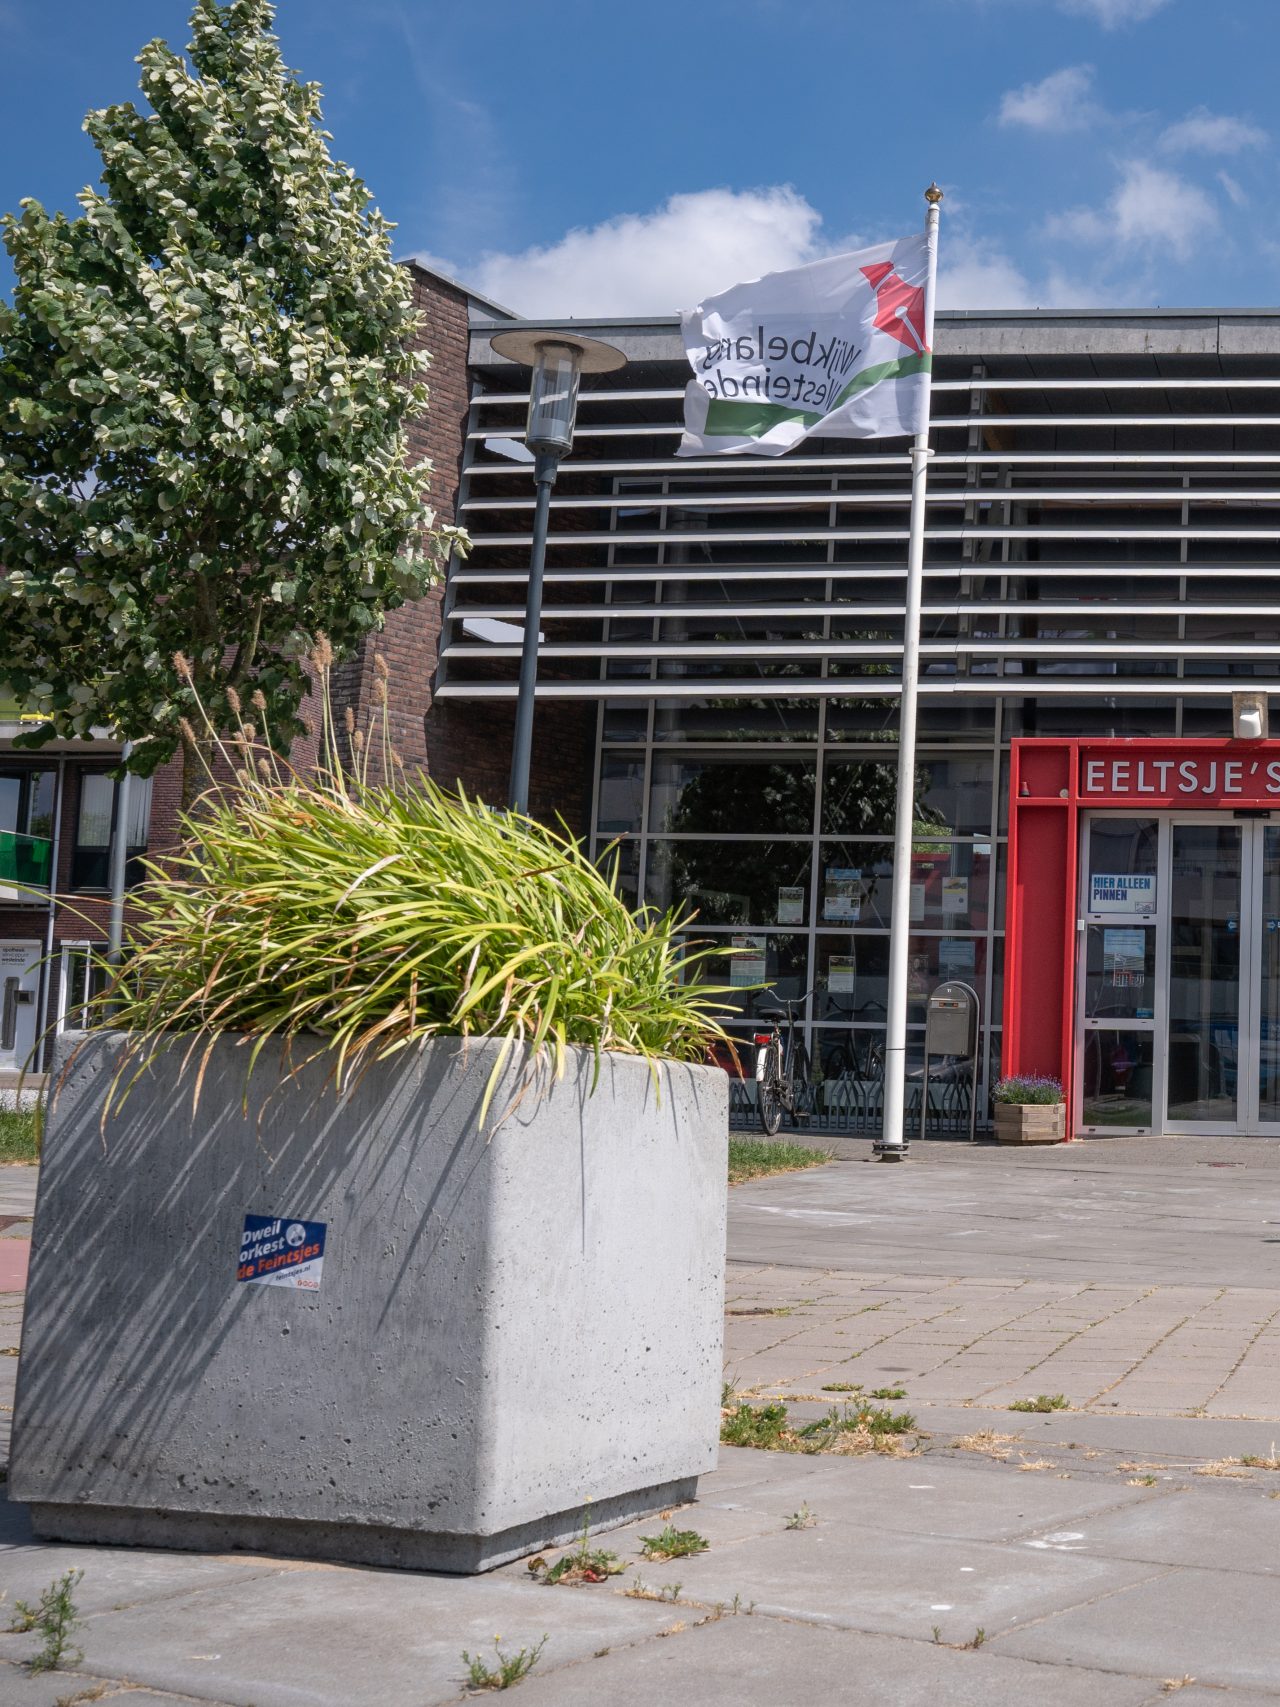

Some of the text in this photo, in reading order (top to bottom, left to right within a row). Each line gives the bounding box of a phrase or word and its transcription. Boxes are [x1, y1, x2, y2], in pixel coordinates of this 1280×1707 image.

[1093, 877, 1151, 890] HIER ALLEEN
[1093, 888, 1128, 901] PINNEN
[241, 1220, 281, 1246] Dweil
[239, 1236, 286, 1263] orkest
[237, 1242, 321, 1279] de Feintsjes
[275, 1264, 311, 1281] feintsjes.nl
